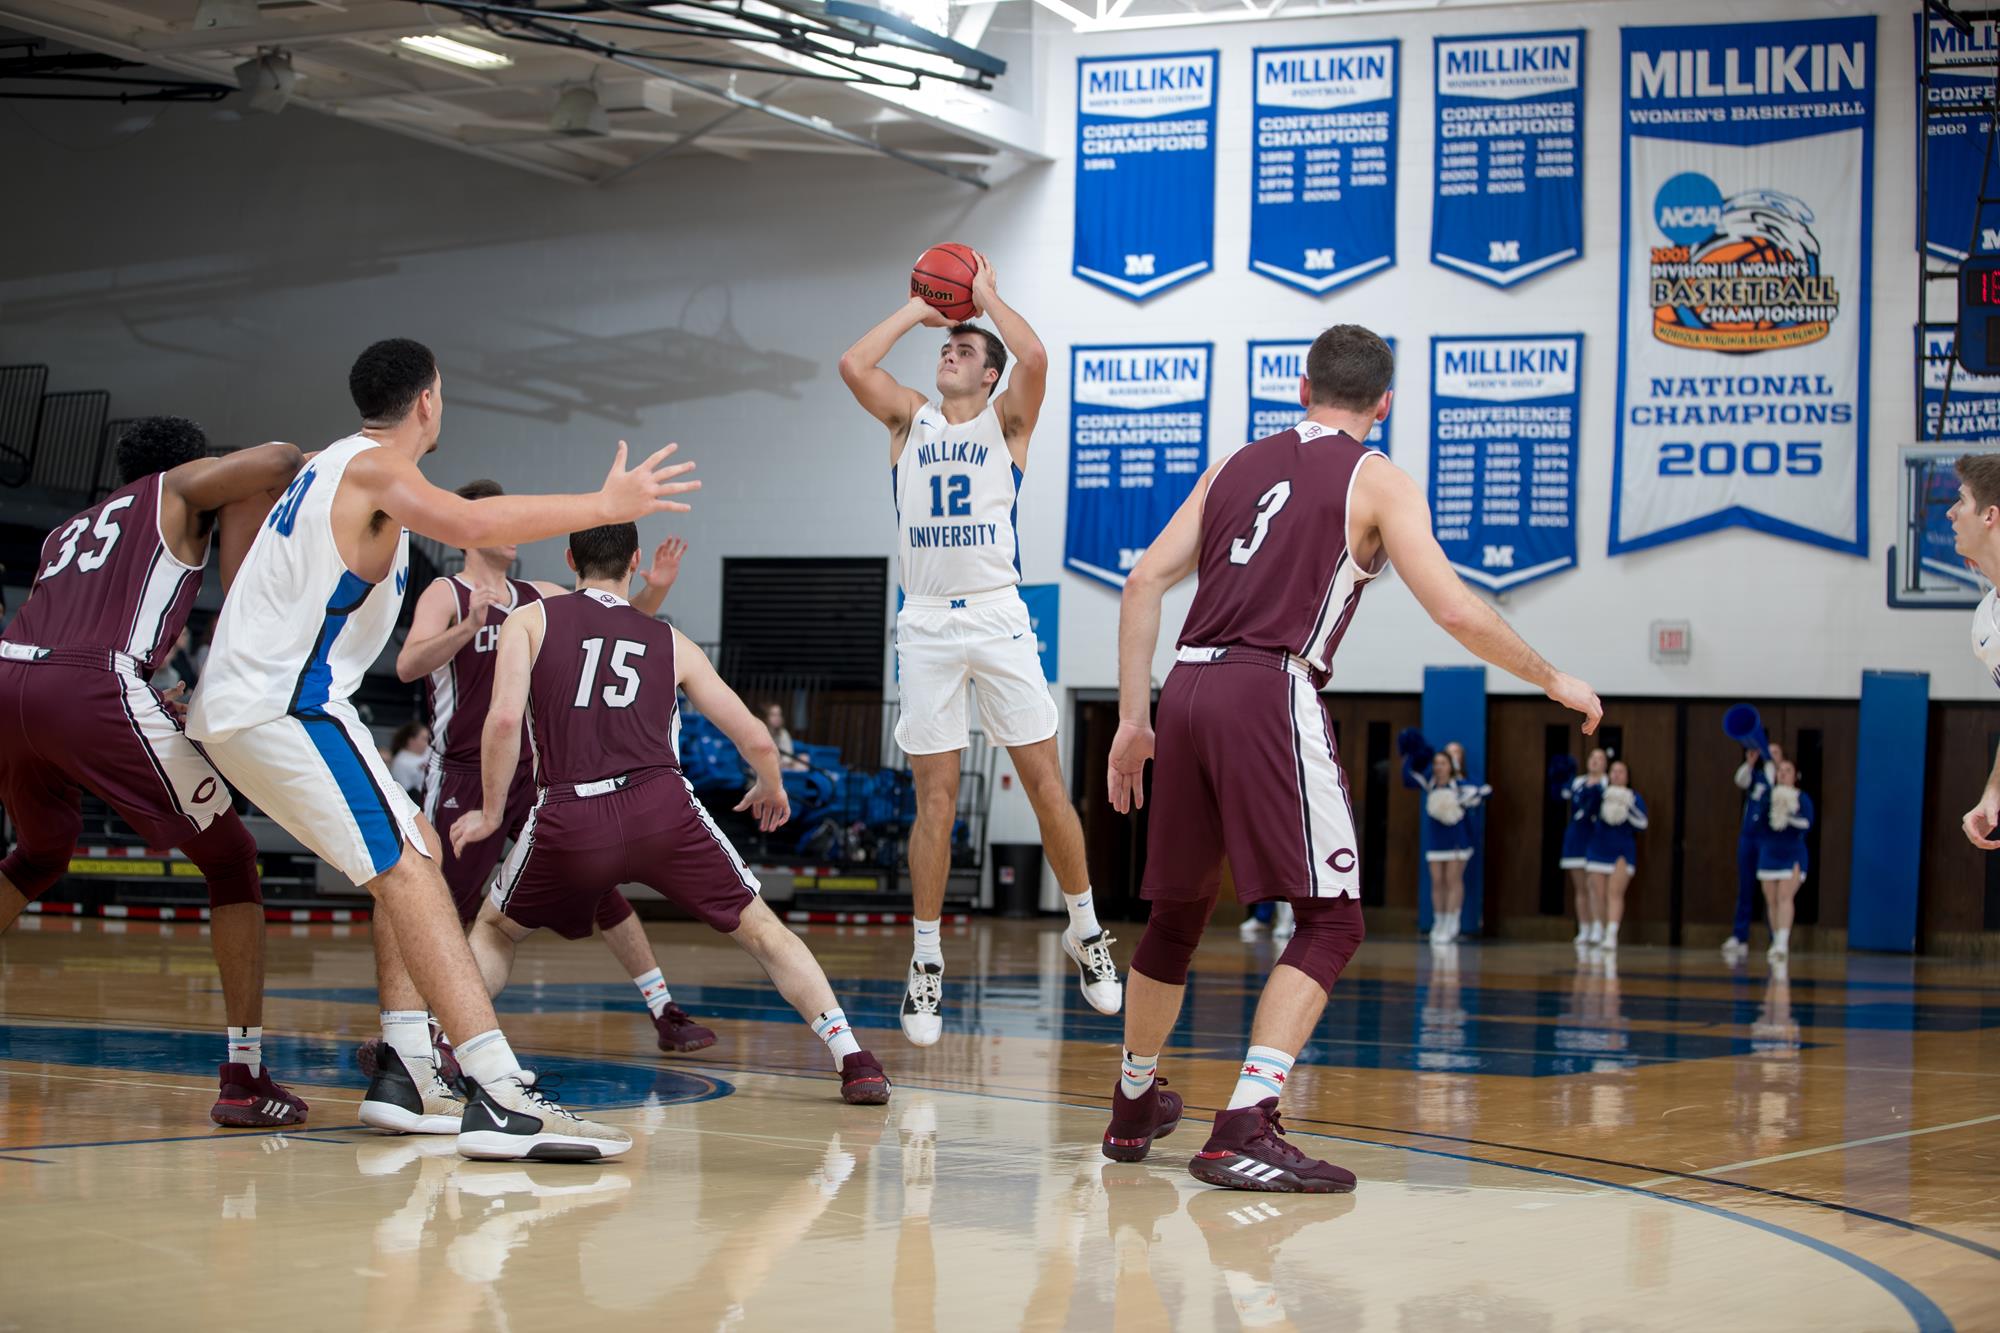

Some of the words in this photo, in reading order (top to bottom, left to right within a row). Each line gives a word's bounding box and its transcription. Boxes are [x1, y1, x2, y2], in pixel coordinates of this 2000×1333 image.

[1265, 55, 1385, 85] MILLIKIN
[1447, 44, 1571, 75] MILLIKIN
[1630, 42, 1865, 99] MILLIKIN
[1089, 65, 1204, 93] MILLIKIN
[1258, 111, 1389, 131] CONFERENCE
[1441, 102, 1575, 122] CONFERENCE
[1630, 107, 1726, 124] WOMEN'S
[1731, 101, 1865, 121] BASKETBALL
[1082, 119, 1208, 139] CONFERENCE
[1258, 127, 1389, 147] CHAMPIONS
[1441, 118, 1575, 138] CHAMPIONS
[1082, 134, 1208, 155] CHAMPIONS
[1659, 206, 1721, 229] NCAA
[1304, 248, 1335, 270] M
[1489, 240, 1520, 262] M
[1124, 254, 1155, 275] M
[1652, 262, 1719, 278] DIVISION
[1721, 262, 1738, 278] III
[1740, 261, 1809, 277] WOMEN'S
[911, 276, 953, 301] Wilson
[1652, 276, 1839, 308] BASKETBALL
[1700, 304, 1839, 322] CHAMPIONSHIP
[1083, 357, 1199, 382] MILLIKIN
[1444, 349, 1568, 374] MILLIKIN
[1650, 375, 1833, 398] NATIONAL
[1076, 412, 1203, 429] CONFERENCE
[1437, 407, 1572, 423] CONFERENCE
[1630, 403, 1853, 426] CHAMPIONS
[1075, 428, 1202, 445] CHAMPIONS
[1437, 423, 1571, 440] CHAMPIONS
[918, 441, 988, 468] MILLIKIN
[1658, 441, 1822, 477] 2005
[929, 474, 972, 518] 12
[1229, 479, 1292, 566] 3
[39, 495, 135, 582] 35
[909, 523, 996, 548] UNIVERSITY
[1482, 545, 1514, 567] M
[950, 599, 967, 609] M
[573, 636, 647, 708] 15
